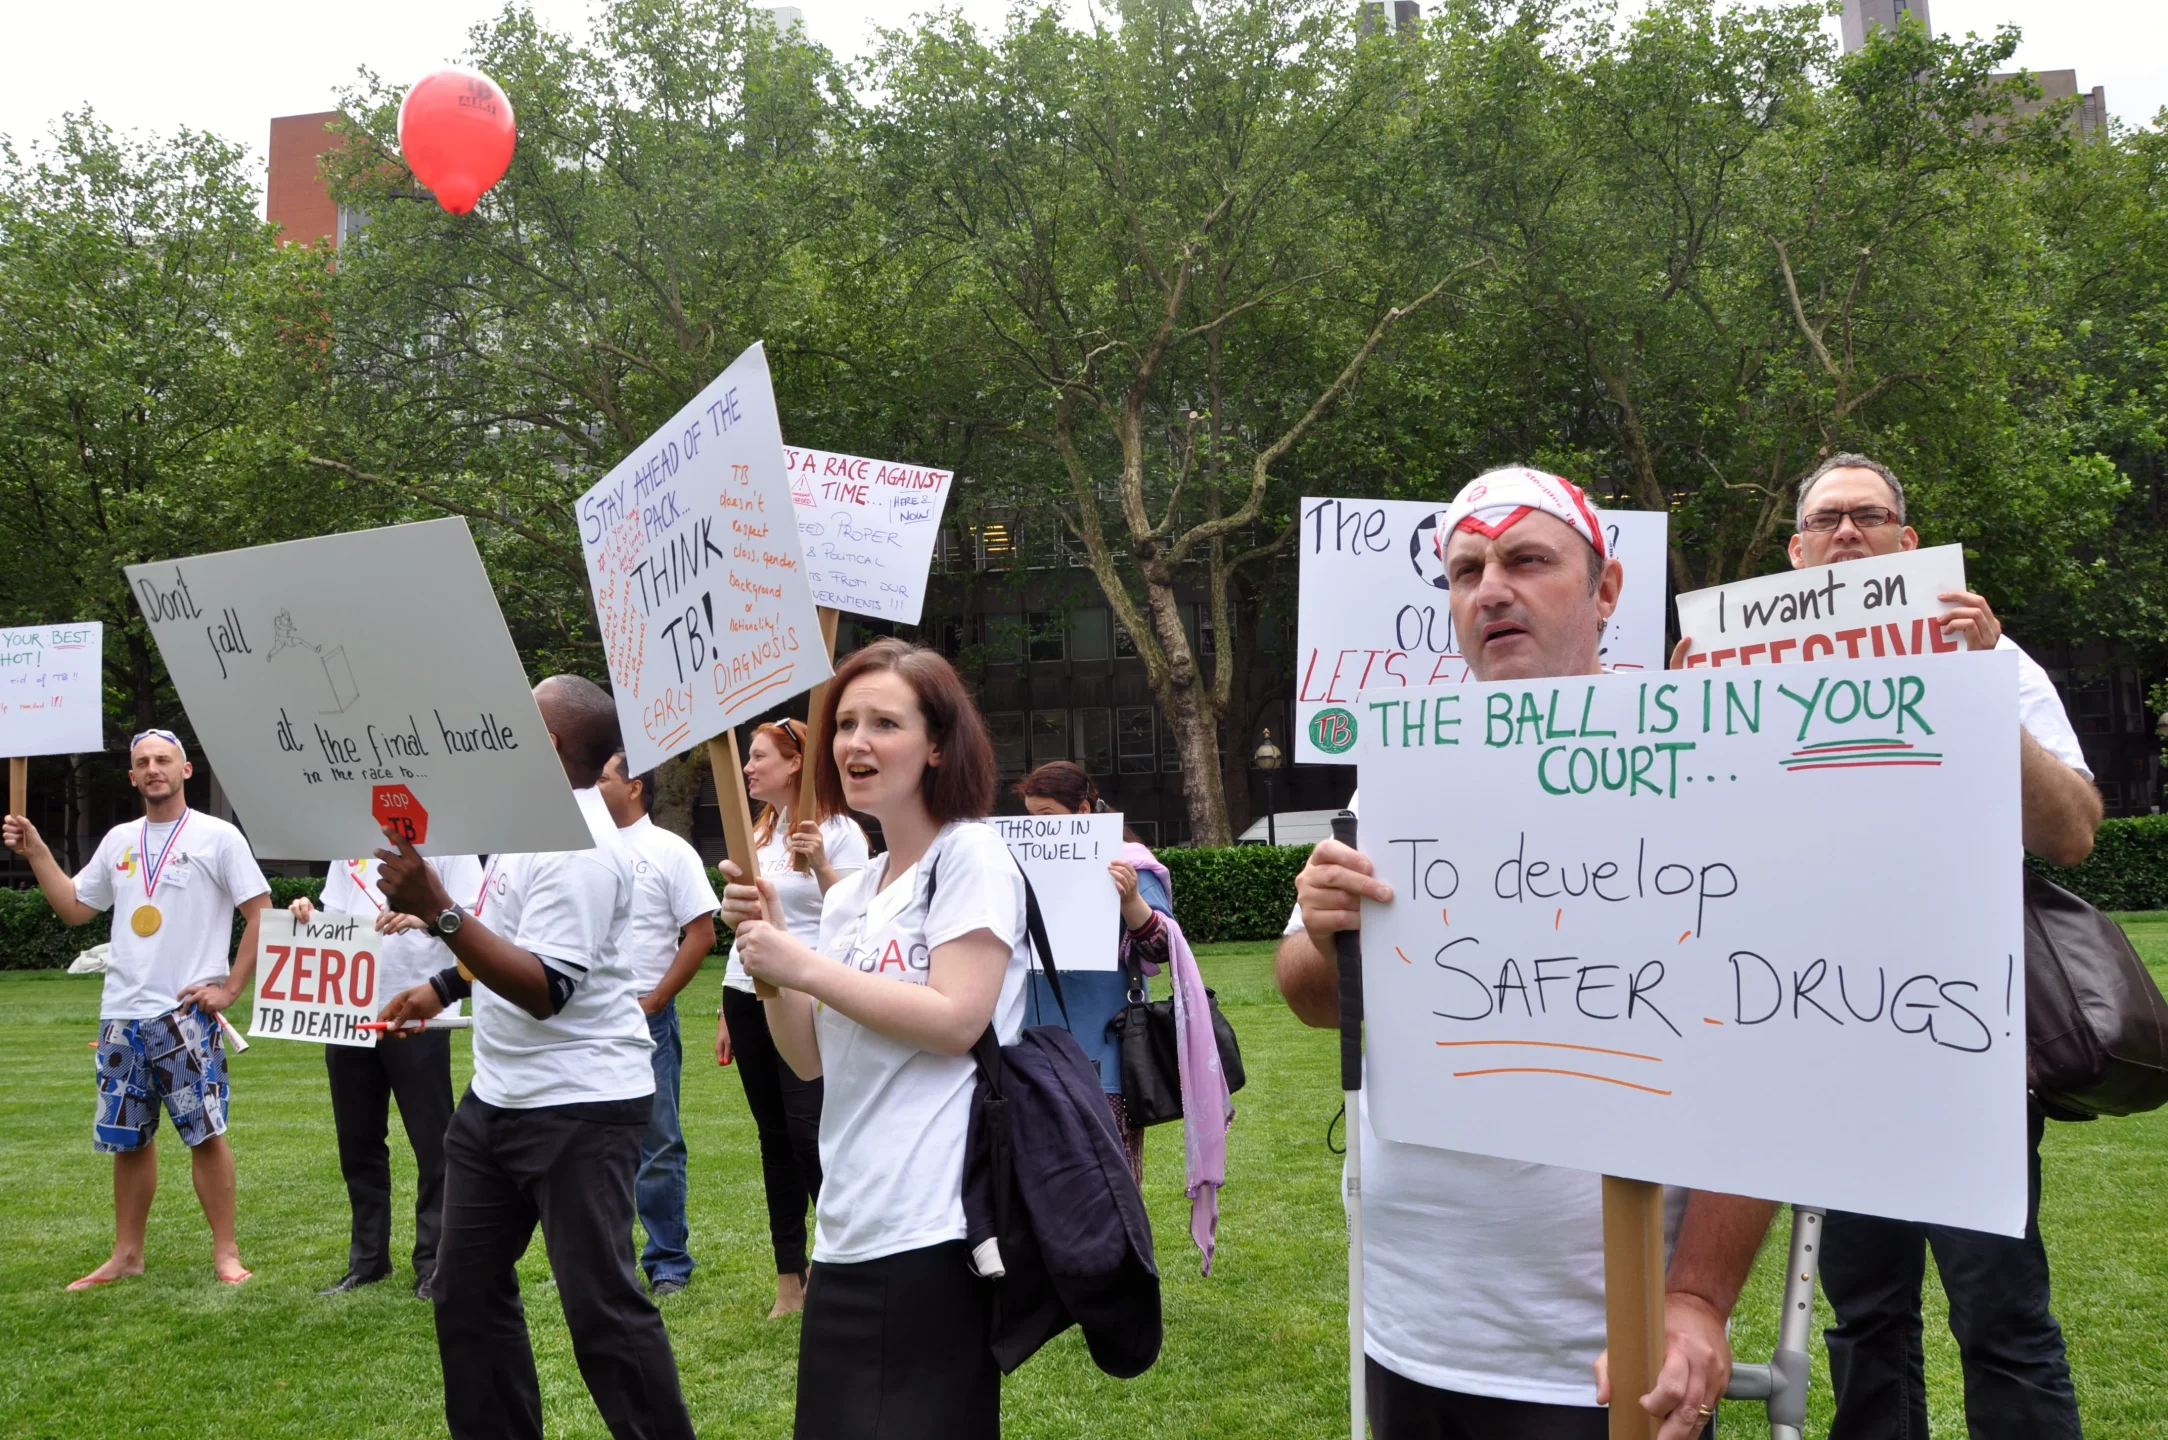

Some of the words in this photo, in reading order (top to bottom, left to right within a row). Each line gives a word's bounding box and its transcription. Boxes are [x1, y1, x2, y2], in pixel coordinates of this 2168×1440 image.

[584, 480, 624, 544] STAY
[634, 441, 679, 505] AHEAD
[684, 420, 701, 460] OF
[707, 386, 742, 436] THE
[731, 464, 749, 486] TB
[802, 454, 816, 474] A
[823, 457, 870, 480] RACE
[875, 465, 949, 493] AGAINST
[719, 488, 764, 512] doesn't
[894, 495, 920, 508] HERE
[900, 509, 931, 522] NOW
[797, 521, 825, 537] EED
[831, 511, 902, 548] PROPER
[1305, 498, 1391, 556] The
[630, 515, 723, 617] THINK
[821, 542, 885, 568] POLITICAL
[137, 565, 203, 623] Don't
[729, 569, 781, 602] background
[812, 590, 882, 610] VERNMENTS
[880, 581, 909, 598] OUR
[1719, 591, 1726, 633] I
[1743, 569, 1846, 629] want
[1863, 574, 1908, 609] an
[2, 631, 44, 649] YOUR
[52, 630, 91, 645] BEST
[206, 607, 252, 680] fall
[661, 591, 718, 684] TB!
[1396, 604, 1462, 655] OU
[52, 673, 68, 681] TB
[643, 682, 693, 740] EARLY
[714, 626, 799, 695] DIAGNOSIS
[1314, 712, 1352, 747] TB
[1369, 695, 1462, 748] THE
[1485, 685, 1617, 749] BALL
[1637, 683, 1679, 734] IS
[1703, 679, 1762, 735] IN
[1777, 675, 1936, 742] YOUR
[277, 707, 304, 752] at
[313, 722, 362, 765] the
[366, 714, 430, 767] final
[433, 708, 519, 755] hurdle
[302, 767, 323, 784] in
[330, 767, 355, 781] the
[361, 767, 394, 780] race
[1538, 742, 1738, 799] COURT...
[380, 791, 409, 811] stop
[387, 816, 417, 842] TB
[995, 819, 1062, 838] THROW
[1071, 820, 1091, 836] IN
[1018, 842, 1087, 862] TOWEL
[1389, 838, 1460, 900] To
[1493, 831, 1739, 938] develop
[306, 916, 359, 942] want
[260, 944, 376, 1008] ZERO
[1431, 936, 1683, 1038] SAFER
[1728, 950, 2013, 1053] DRUGS!
[258, 1007, 285, 1033] TB
[291, 1010, 371, 1042] DEATHS
